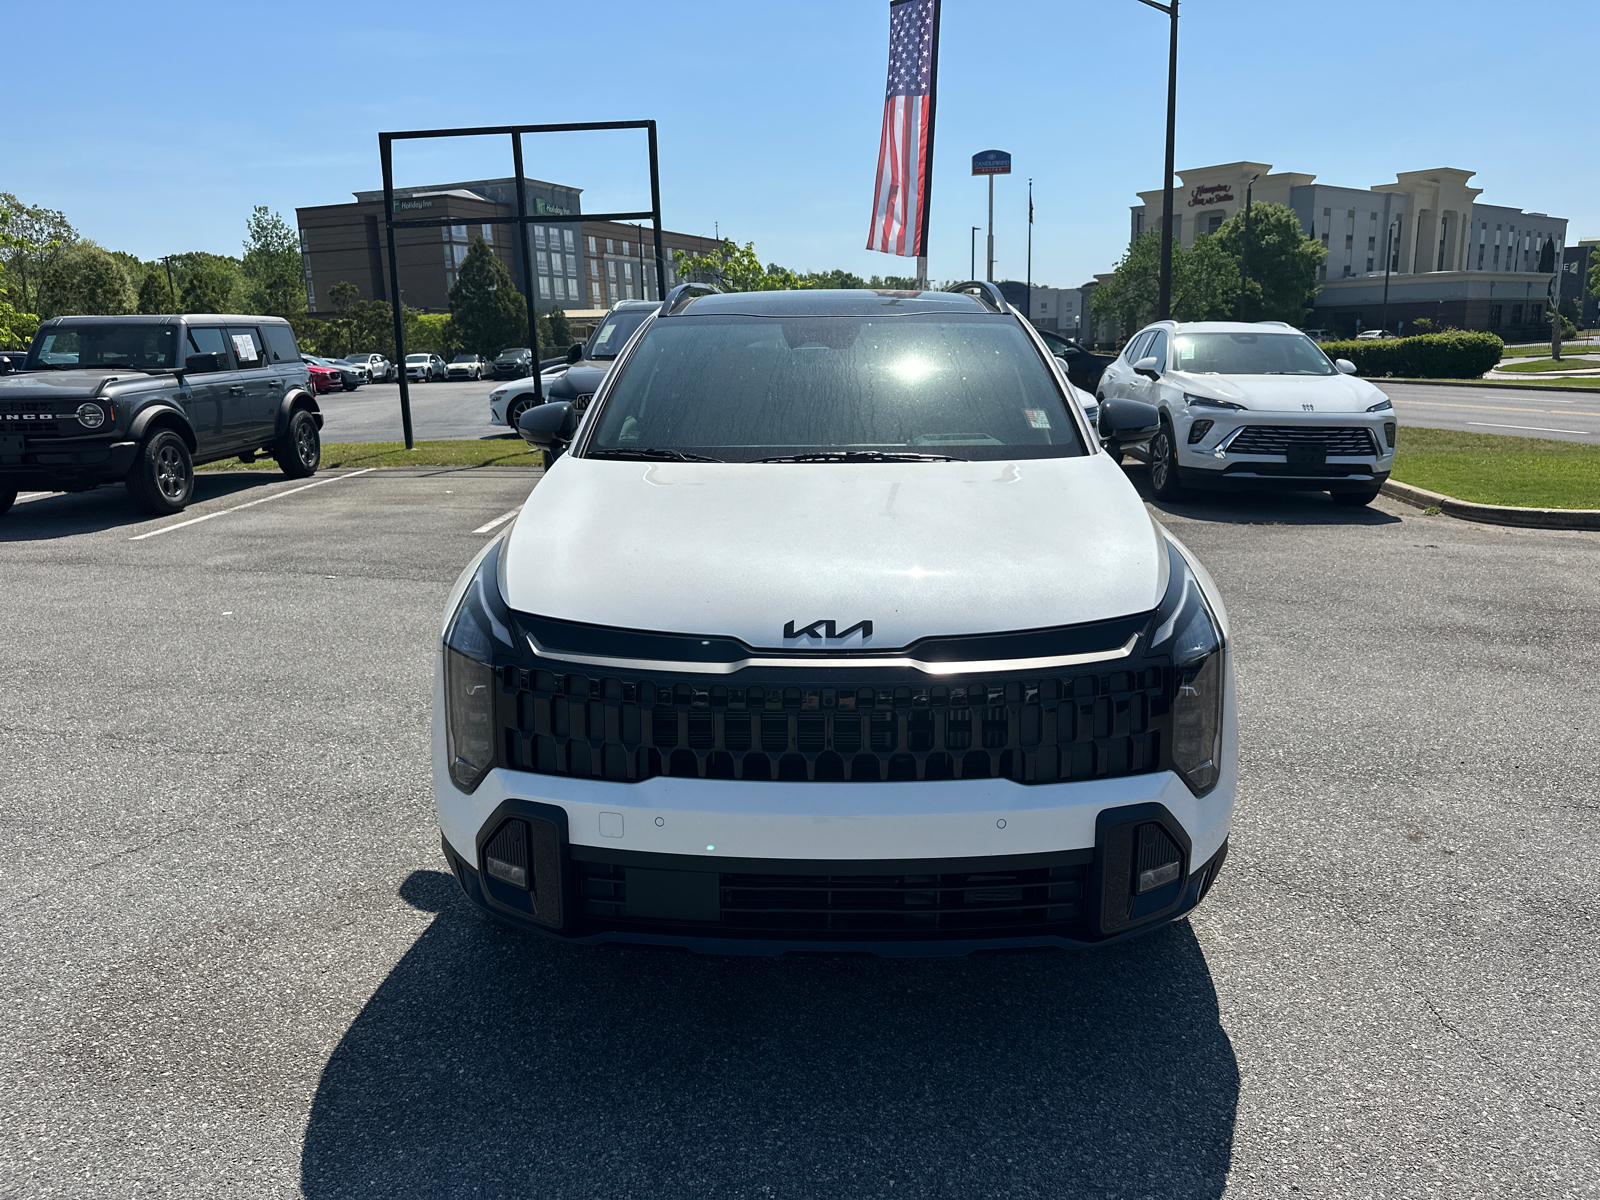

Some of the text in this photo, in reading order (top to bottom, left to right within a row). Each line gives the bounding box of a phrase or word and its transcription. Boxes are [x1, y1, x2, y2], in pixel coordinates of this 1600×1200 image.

[1191, 184, 1231, 197] Hampton
[401, 201, 422, 210] Holiday
[546, 203, 563, 216] Holiday
